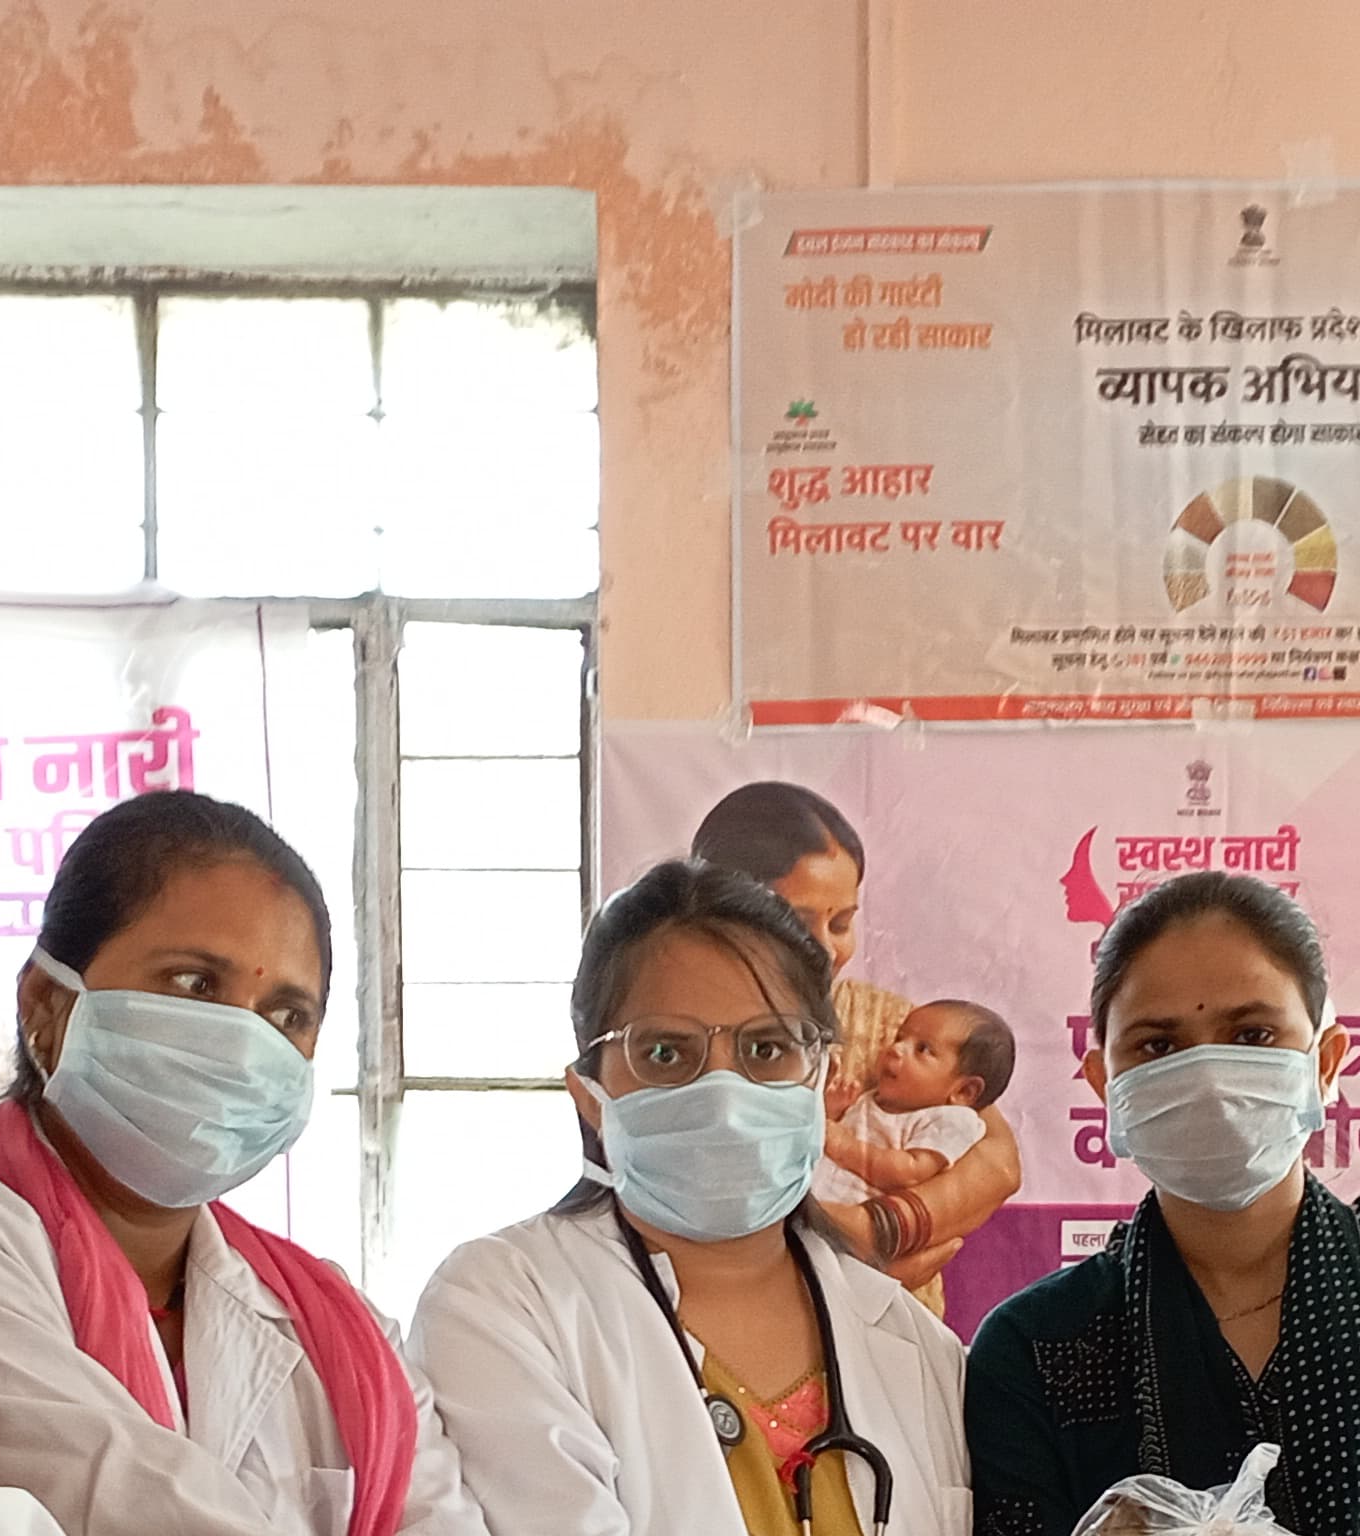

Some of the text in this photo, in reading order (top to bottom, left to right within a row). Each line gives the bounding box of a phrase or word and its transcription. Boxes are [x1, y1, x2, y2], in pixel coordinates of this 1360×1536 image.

[785, 275, 837, 308] मोदी
[842, 273, 874, 307] की
[843, 315, 993, 350] हो रही साकार
[1074, 310, 1170, 344] मिलावट
[1178, 309, 1203, 342] के
[1210, 310, 1304, 343] खिलाफ
[1096, 365, 1231, 406] व्यापक
[1183, 424, 1206, 445] का
[767, 464, 934, 510] शुद्ध आहार
[768, 515, 1005, 556] मिलावट पर वार
[24, 705, 200, 803] नारी
[1116, 824, 1301, 872] स्वस्थ नारी
